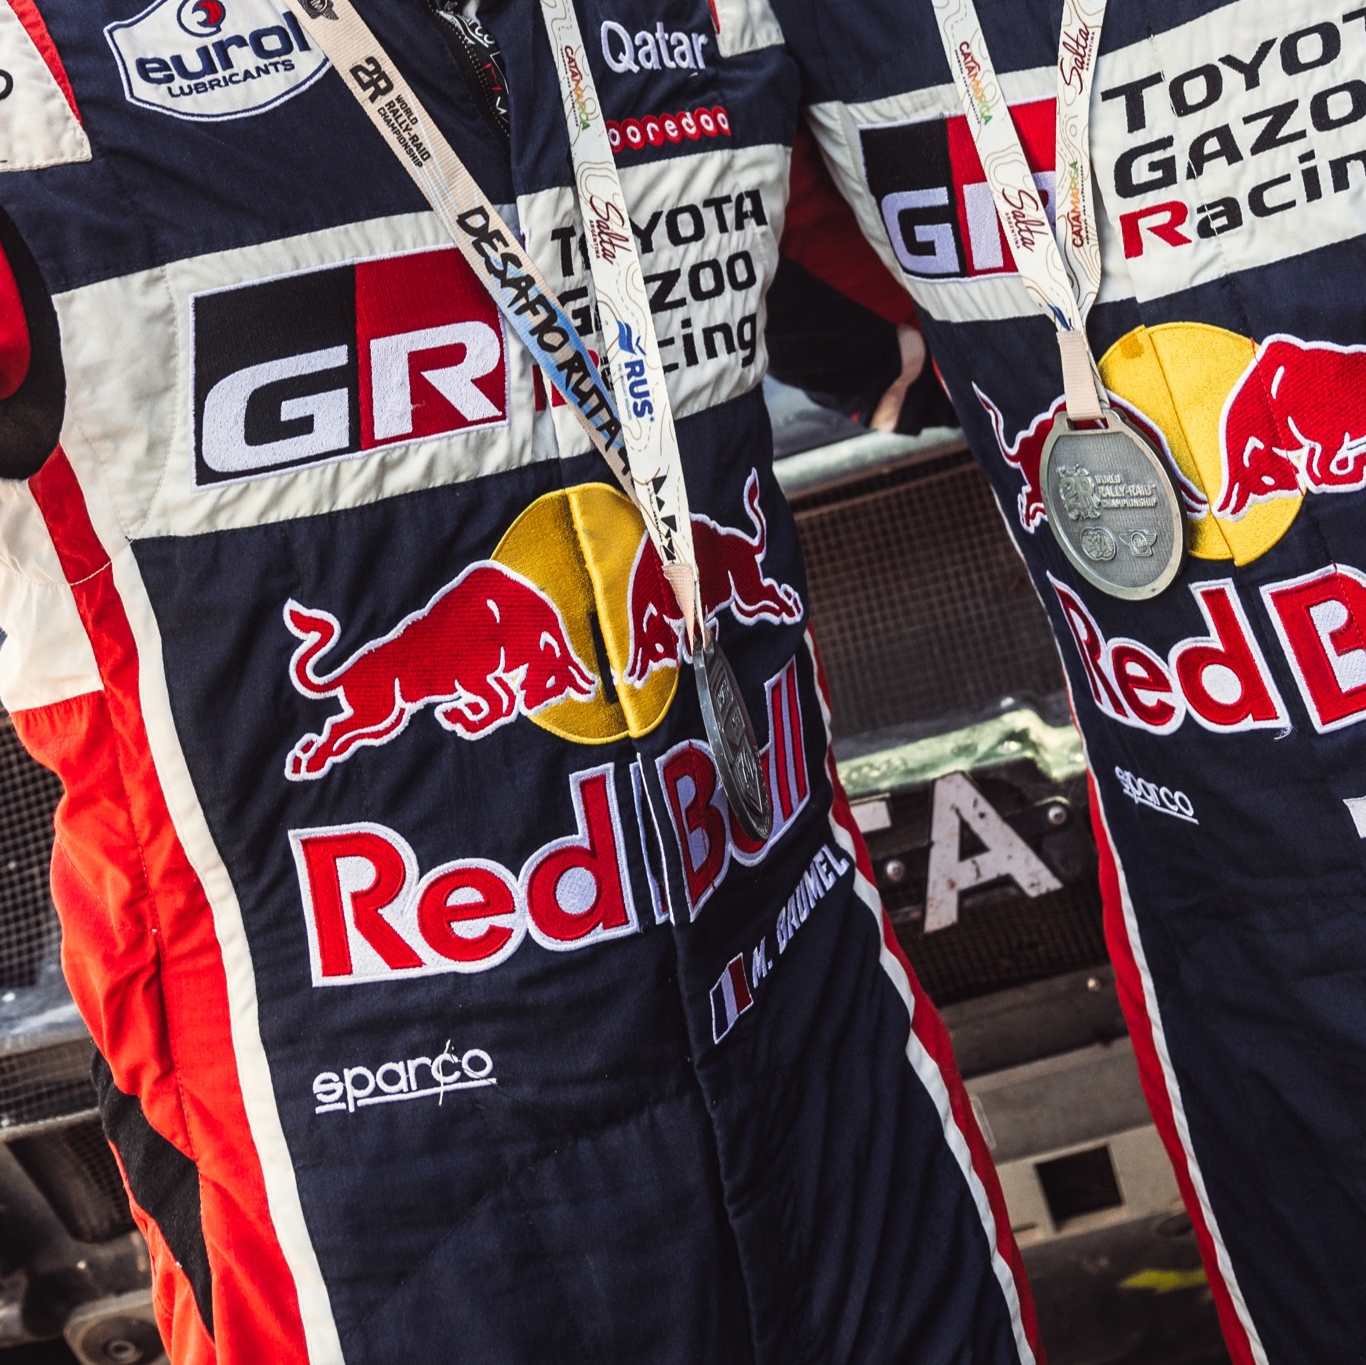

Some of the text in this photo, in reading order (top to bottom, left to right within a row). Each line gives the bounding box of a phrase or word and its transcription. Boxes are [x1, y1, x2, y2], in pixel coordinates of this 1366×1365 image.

[135, 10, 313, 85] eurol
[166, 58, 296, 99] LUBRICANTS
[600, 19, 709, 74] Qatar
[1059, 22, 1090, 96] Salta
[1085, 31, 1096, 71] ARGENTINA
[394, 93, 419, 127] WORLD
[564, 44, 591, 131] CATAMARCA
[958, 40, 993, 126] CATAMARCA
[377, 106, 424, 169] CHAMPIONSHIP
[384, 99, 432, 163] RALLY-RAID
[606, 107, 730, 150] ooredoo
[550, 188, 769, 278] TYOTA
[589, 194, 632, 266] Salta
[1001, 187, 1049, 253] Salta
[1004, 212, 1021, 250] ARGENTINA
[1066, 160, 1085, 249] CATAMARCA
[588, 219, 601, 260] ARGENTINA
[560, 250, 758, 337] GZOO
[455, 204, 623, 453] DESAFIO RUTA
[201, 319, 504, 474] GR
[623, 358, 653, 419] RUS
[1094, 474, 1122, 485] WORLD
[1055, 583, 1283, 728] Red
[1114, 765, 1194, 817] sparco
[300, 771, 632, 980] Red
[751, 844, 850, 989] M. BAUMEL
[313, 1047, 496, 1112] sparco
